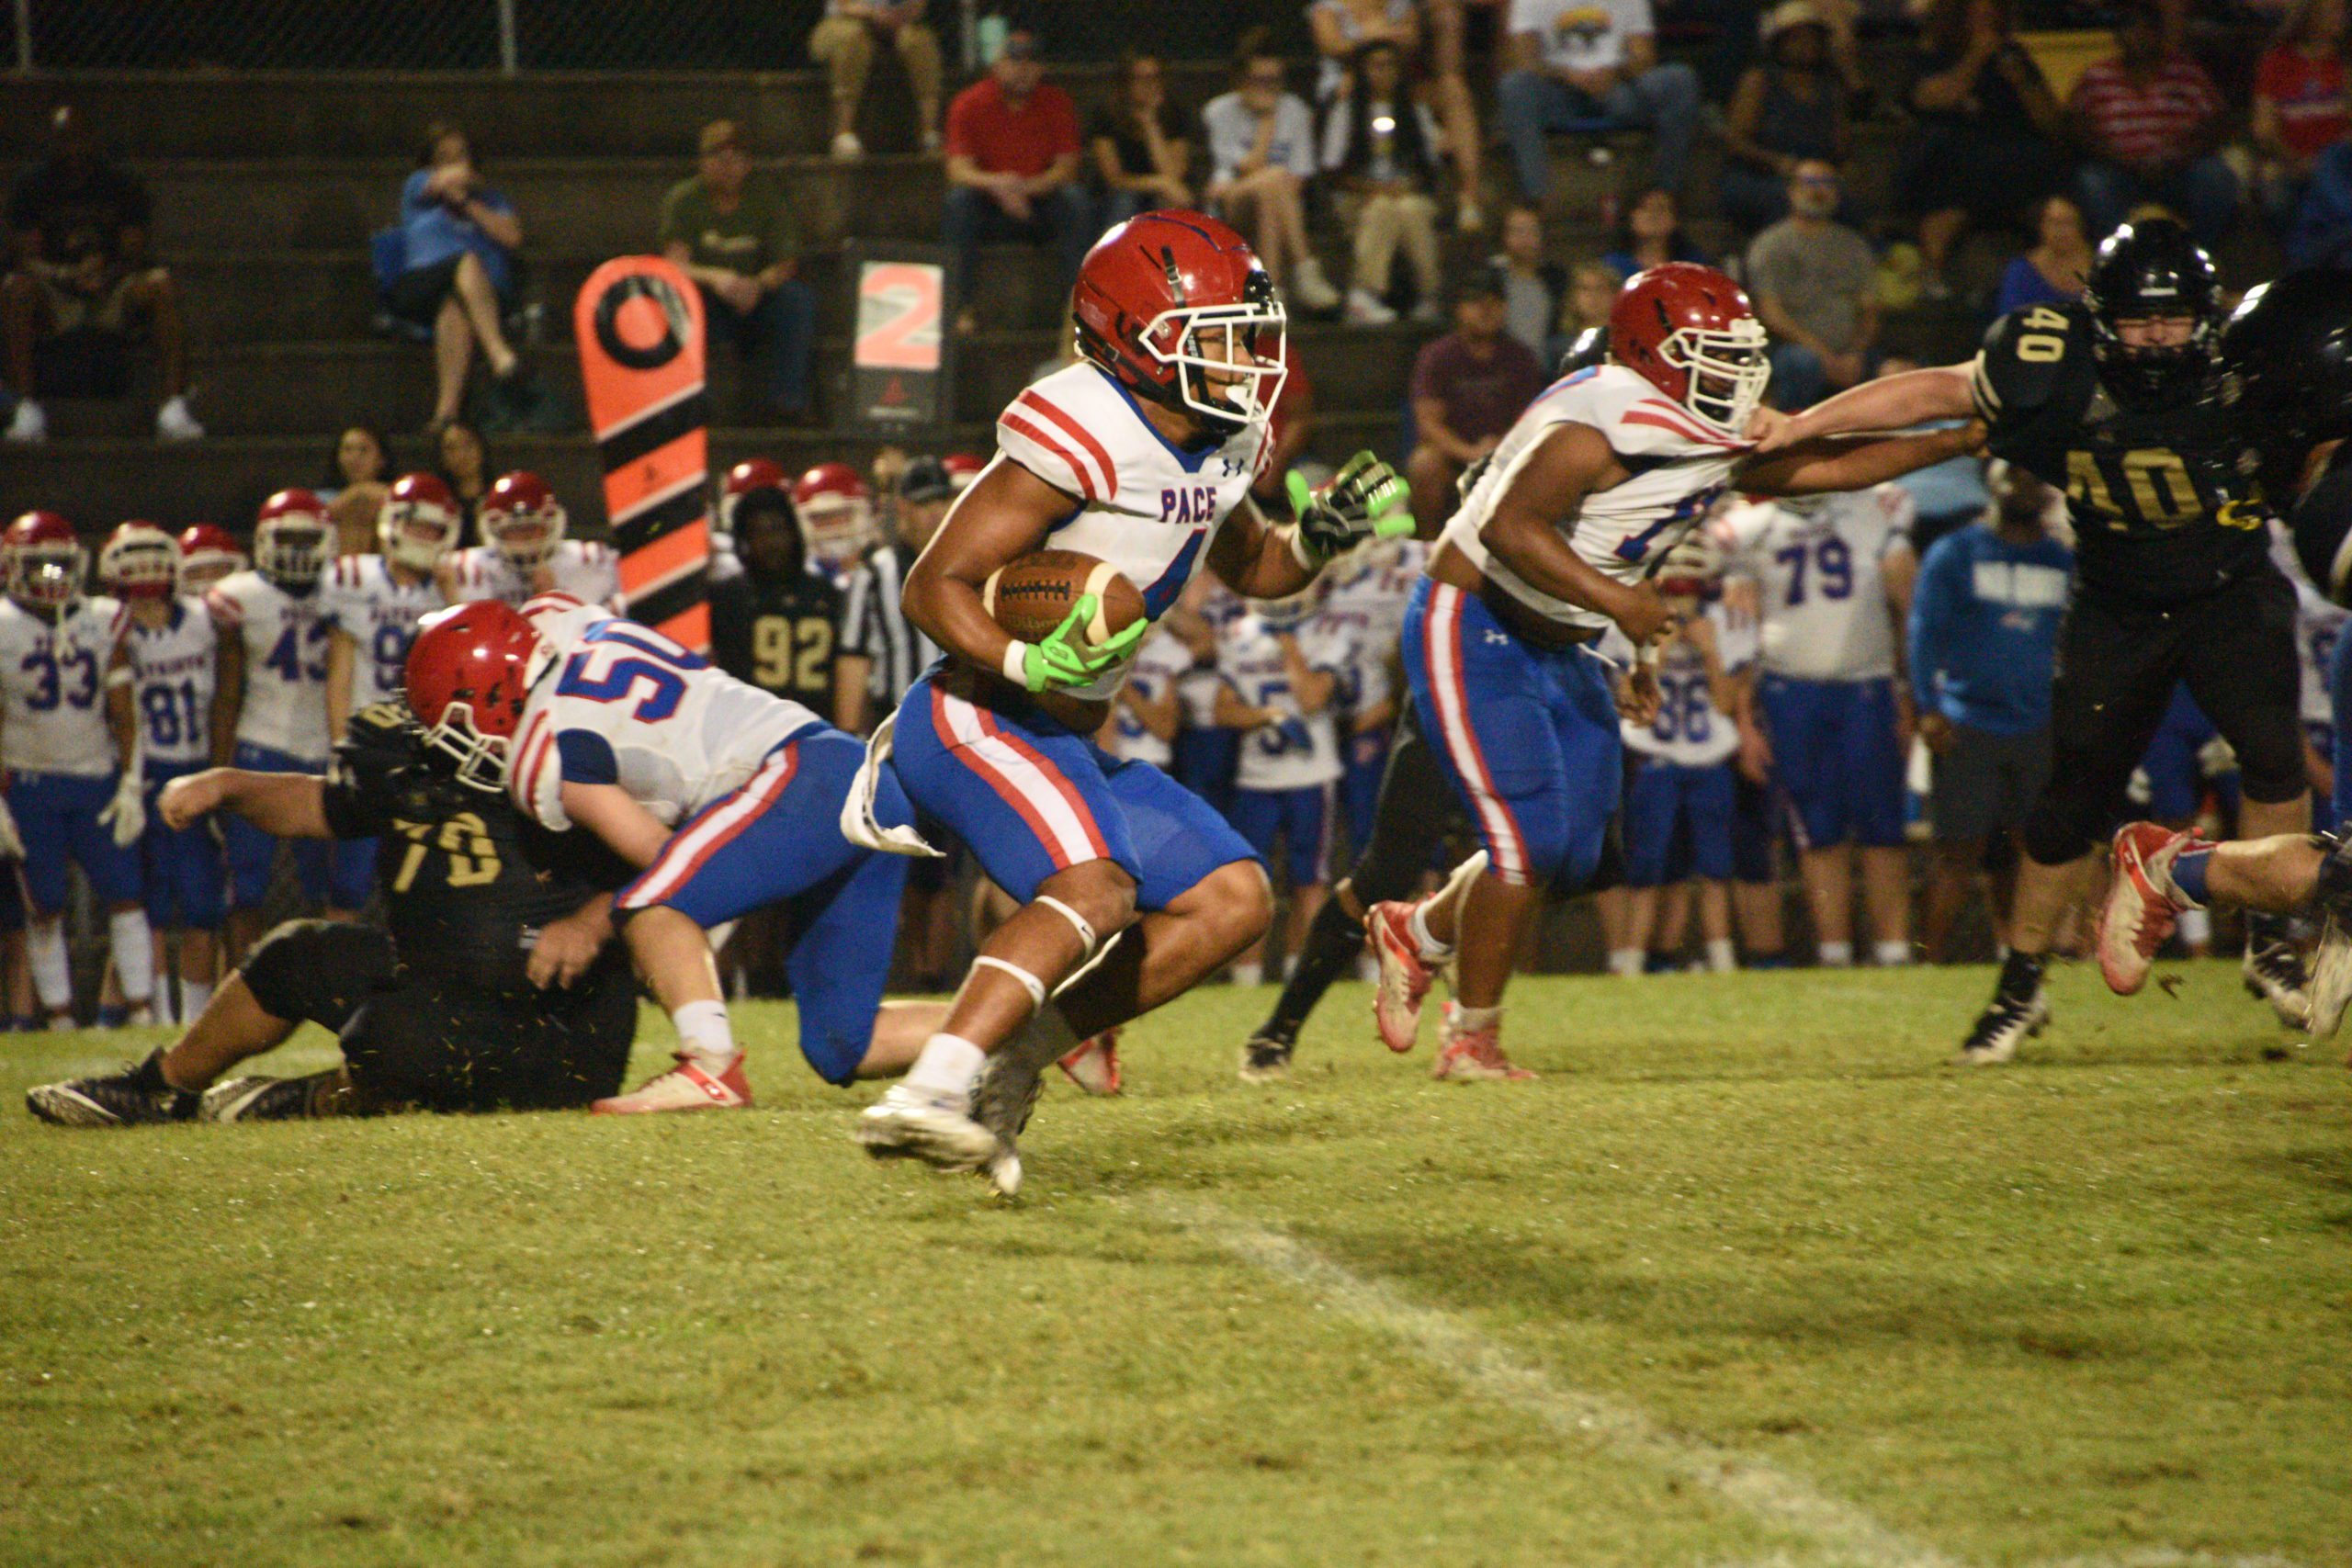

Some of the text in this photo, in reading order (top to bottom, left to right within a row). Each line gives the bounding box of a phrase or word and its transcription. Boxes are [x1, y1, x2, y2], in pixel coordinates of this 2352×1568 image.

[856, 264, 939, 364] 2
[2017, 308, 2068, 362] 40
[1158, 486, 1217, 524] PACE
[1776, 536, 1853, 606] 79
[21, 647, 98, 710] 33
[555, 618, 714, 724] 50
[753, 615, 832, 690] 92
[141, 682, 200, 745] 81
